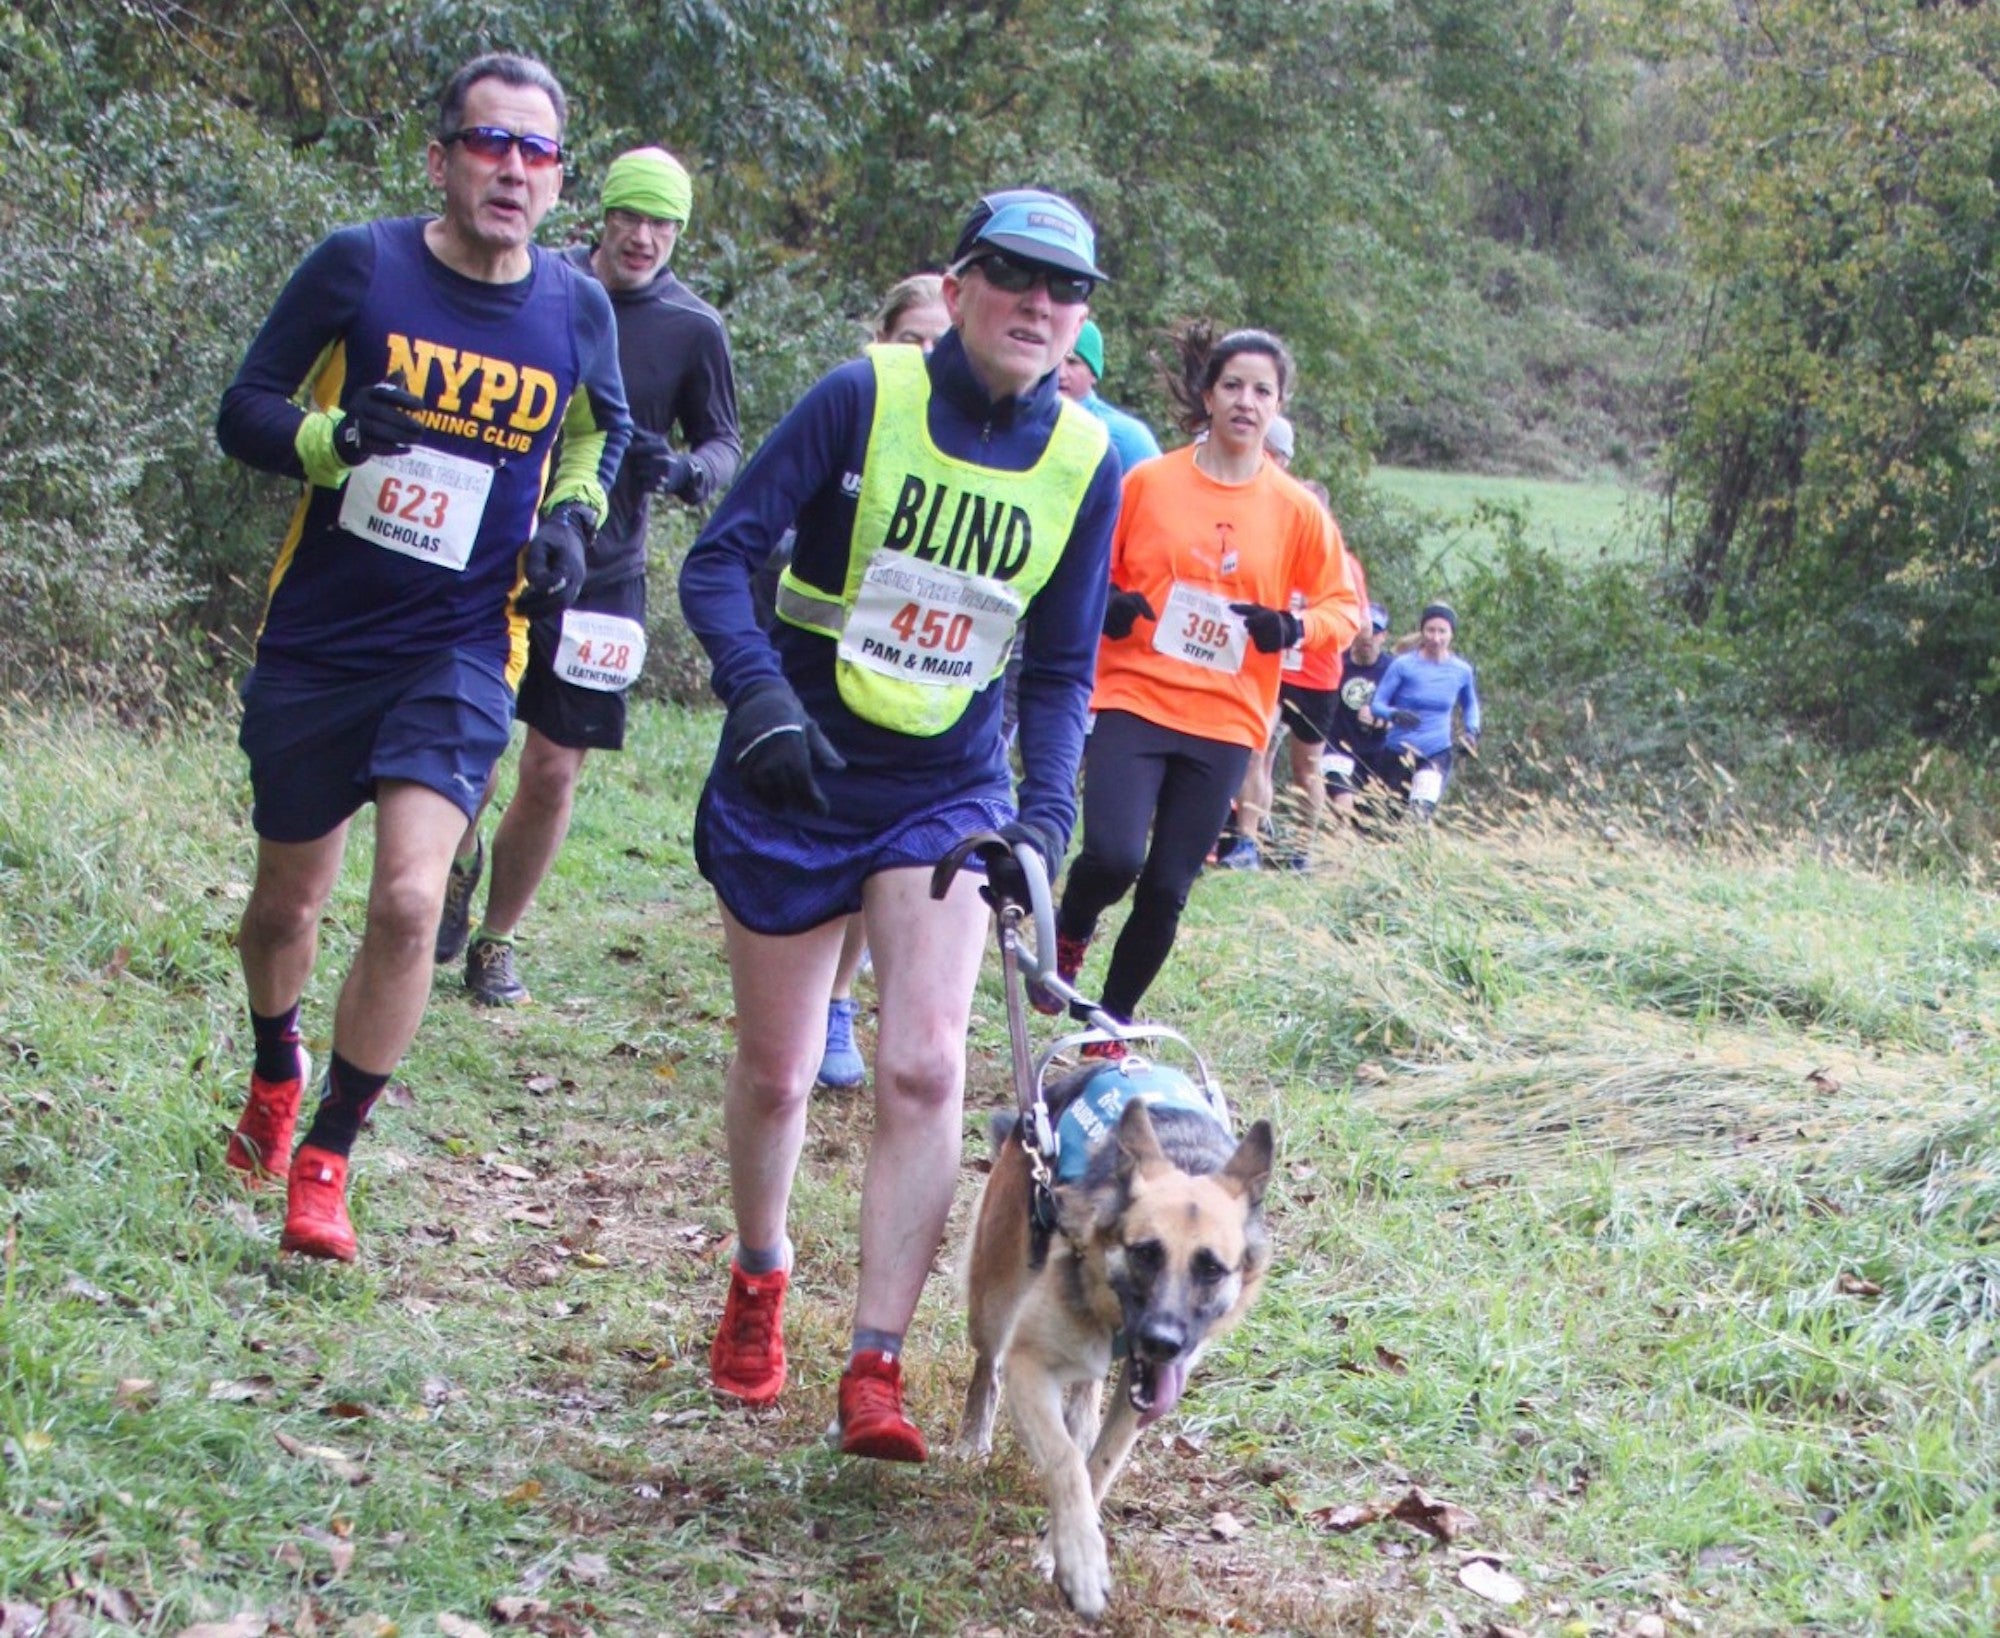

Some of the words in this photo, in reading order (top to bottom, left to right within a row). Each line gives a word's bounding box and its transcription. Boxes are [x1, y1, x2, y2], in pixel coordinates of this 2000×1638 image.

[387, 333, 557, 432] NYPD
[483, 426, 533, 453] CLUB
[377, 476, 449, 530] 623
[367, 515, 441, 553] NICHOLAS
[883, 474, 1032, 582] BLIND
[890, 602, 973, 653] 450
[1182, 612, 1231, 648] 395
[861, 638, 902, 664] PAM
[905, 654, 917, 669] &
[921, 656, 973, 677] MAIDA
[1183, 643, 1216, 661] STEPH
